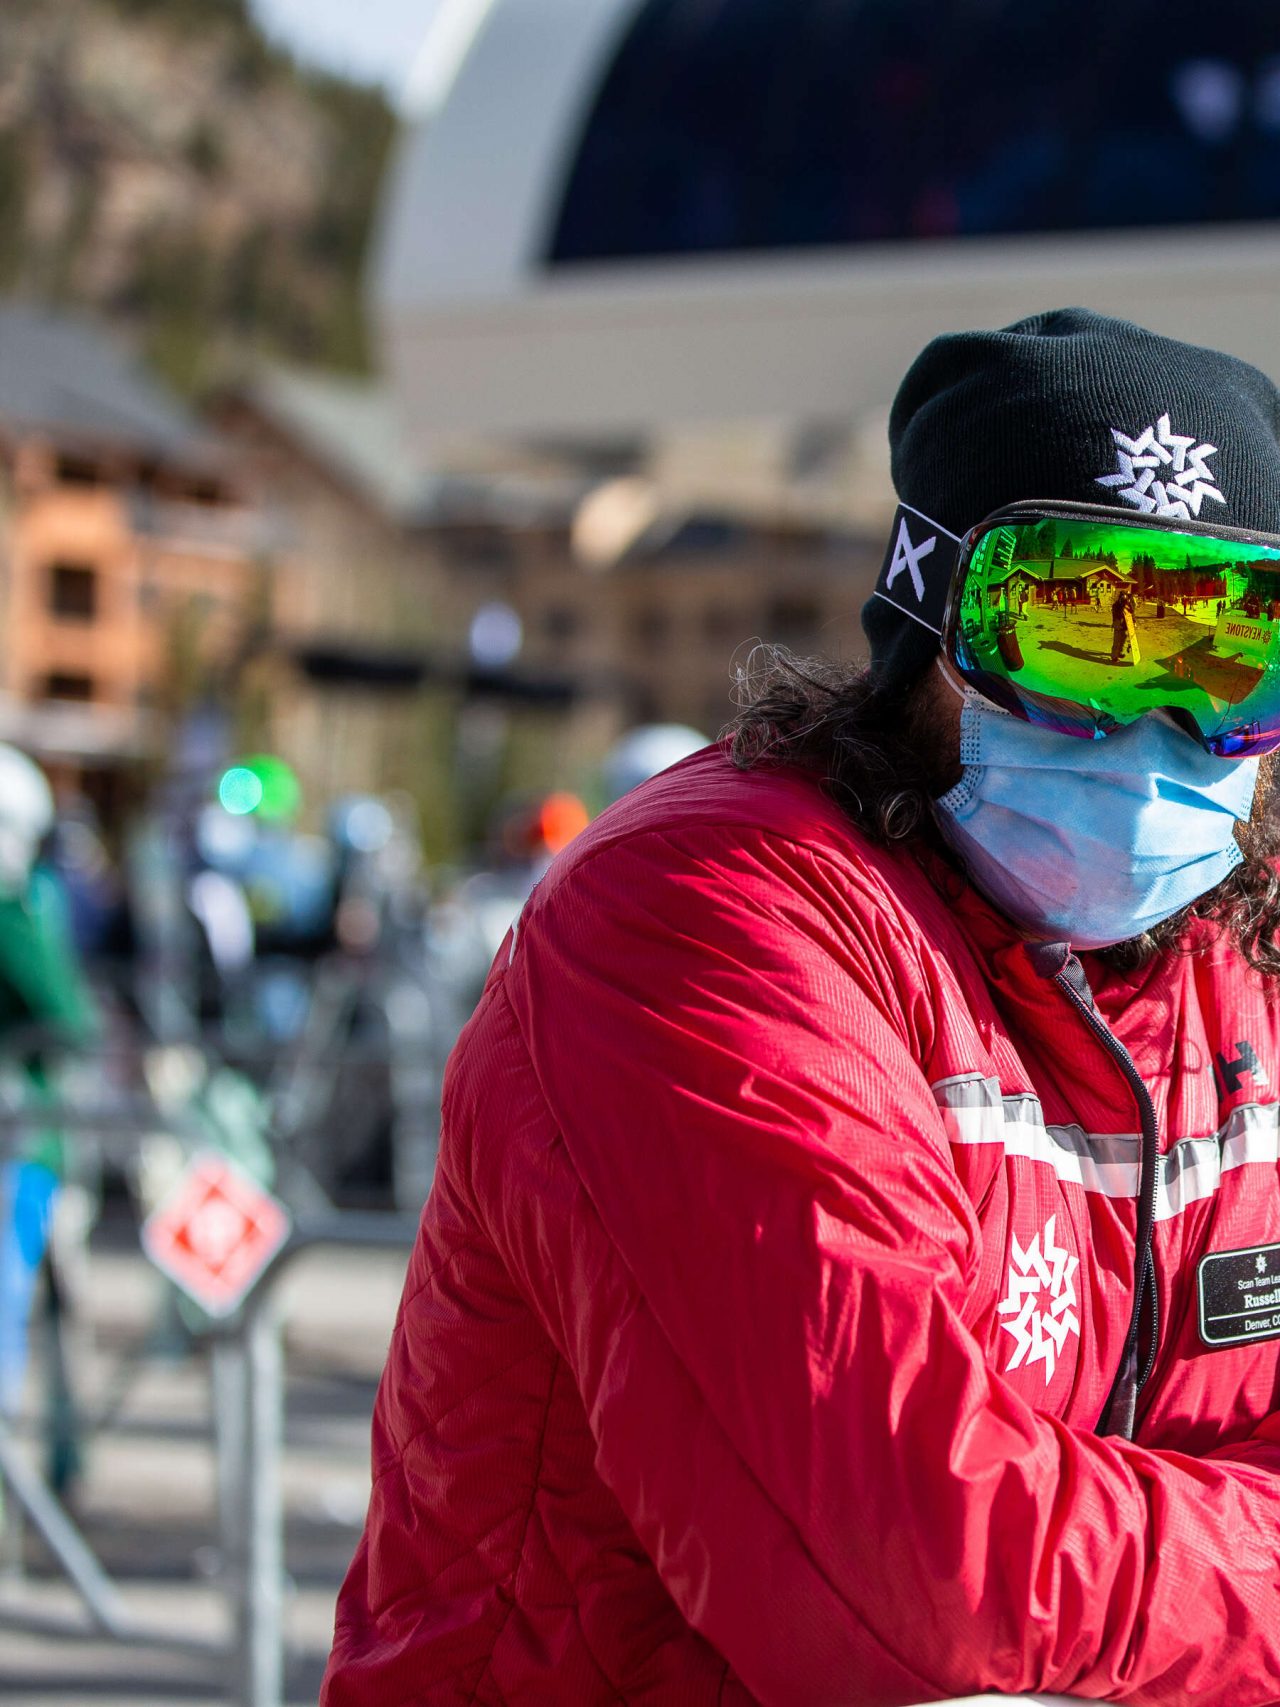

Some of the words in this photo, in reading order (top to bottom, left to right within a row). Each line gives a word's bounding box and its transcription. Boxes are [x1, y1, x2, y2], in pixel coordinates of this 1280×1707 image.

[1237, 1279, 1254, 1290] Scan
[1254, 1276, 1271, 1287] Team
[1244, 1319, 1272, 1331] Denver,
